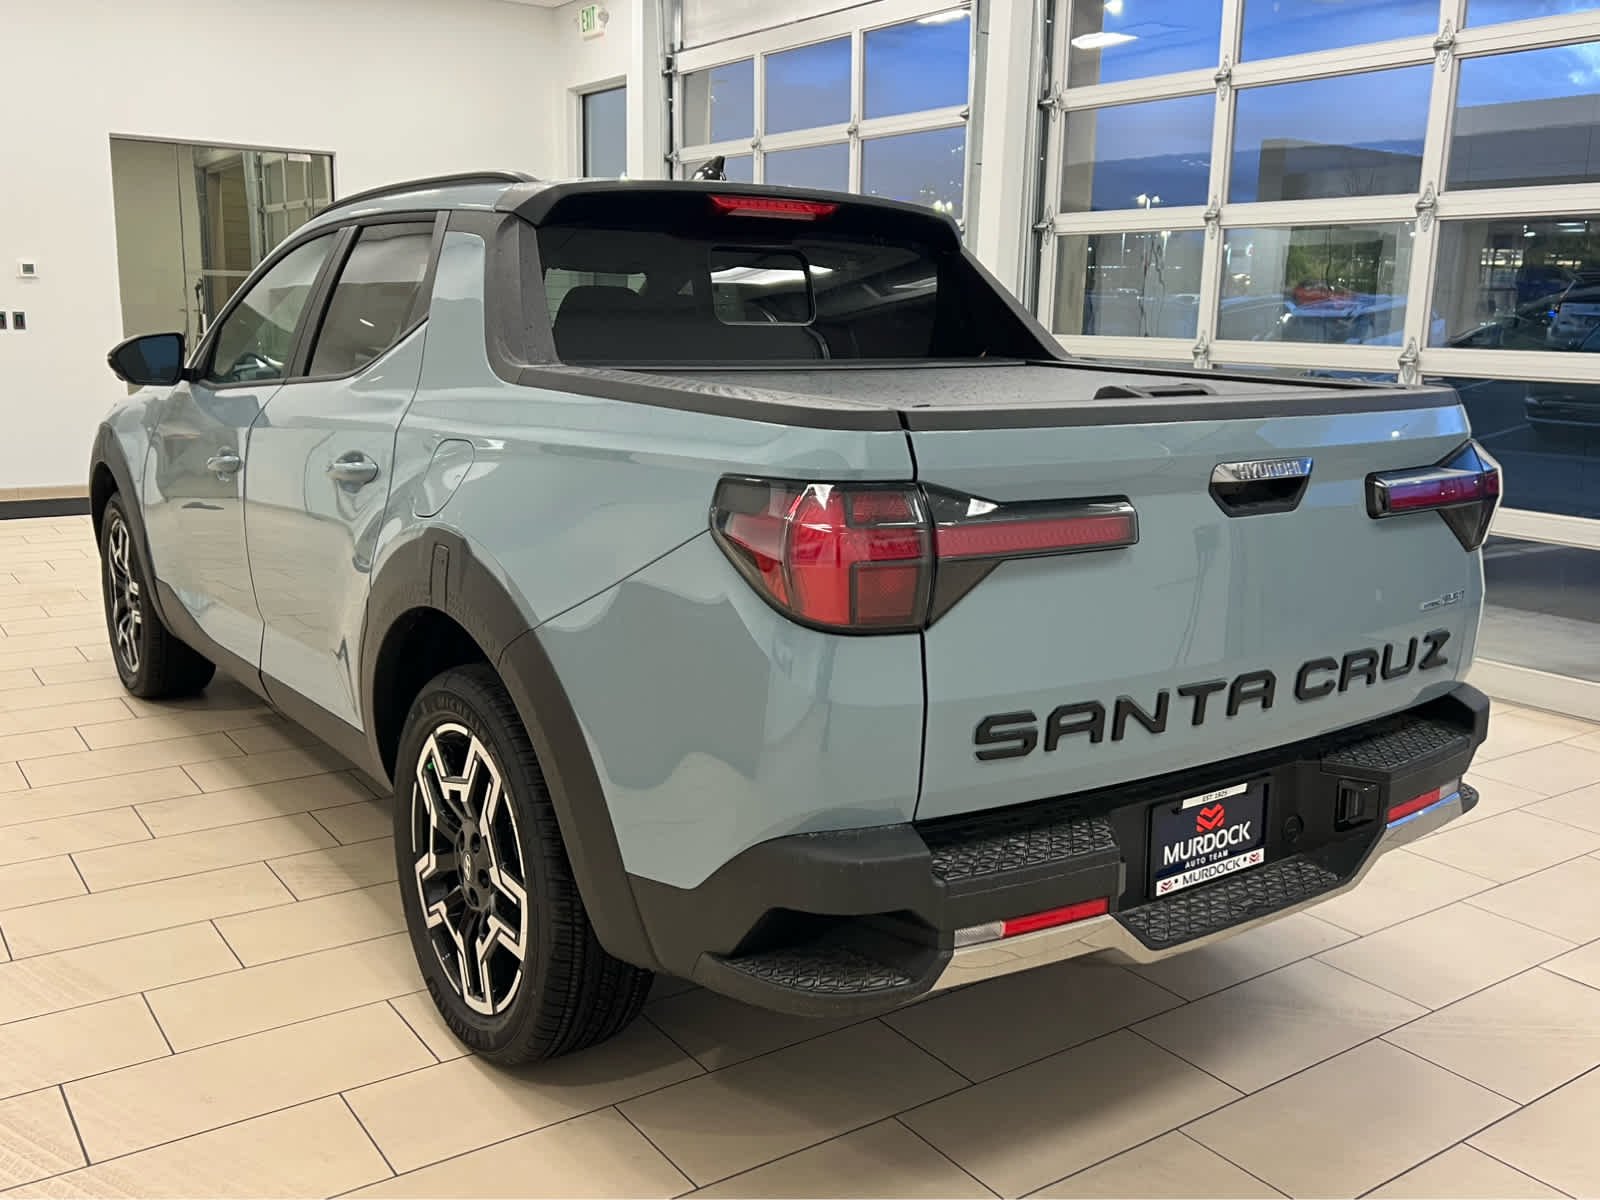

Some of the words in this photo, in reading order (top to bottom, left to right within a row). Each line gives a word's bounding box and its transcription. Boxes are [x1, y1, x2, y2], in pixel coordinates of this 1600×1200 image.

[581, 6, 597, 32] EXIT
[1238, 461, 1302, 480] HYUNDAI
[975, 669, 1277, 761] SANTA
[1294, 629, 1451, 701] CRUZ
[1163, 821, 1251, 866] MURDOCK
[1185, 857, 1207, 869] AUTO
[1209, 849, 1229, 862] TEAM
[1182, 859, 1241, 886] MURDOCK
